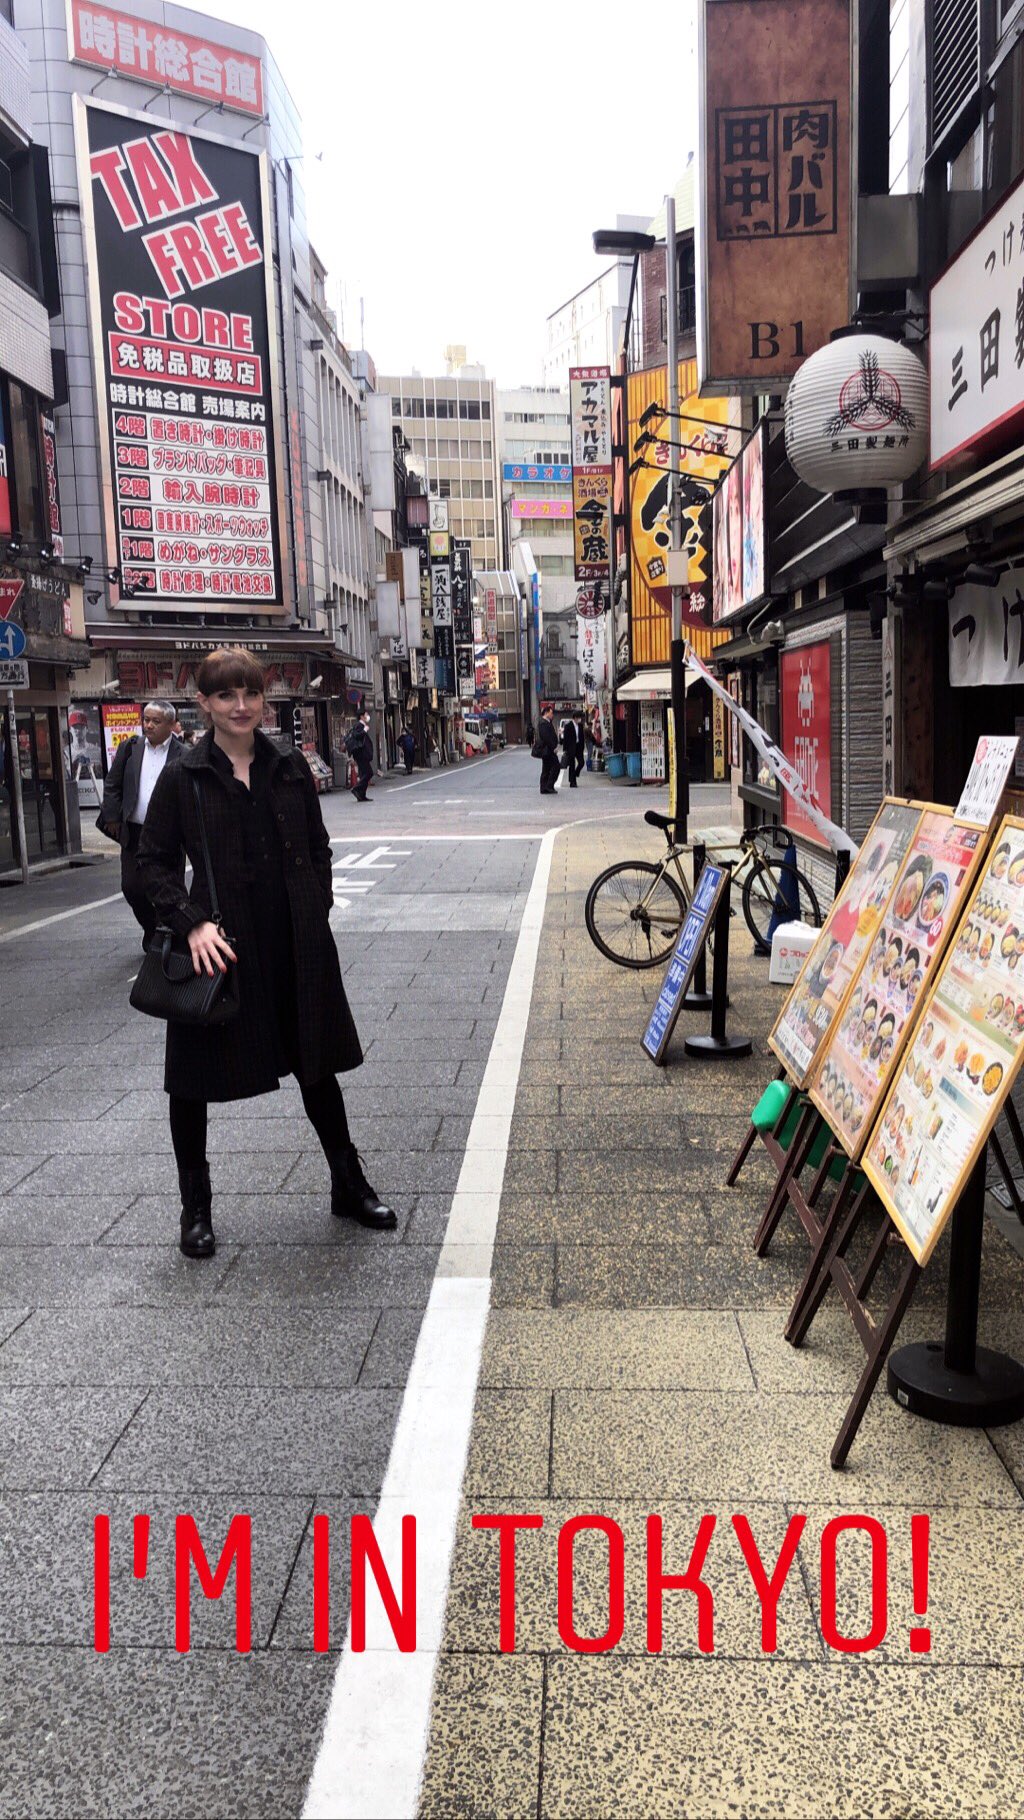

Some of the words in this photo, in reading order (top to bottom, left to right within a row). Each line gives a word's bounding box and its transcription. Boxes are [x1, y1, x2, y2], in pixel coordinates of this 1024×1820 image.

[78, 9, 258, 105] 時計総合館
[89, 130, 219, 232] TAX
[724, 114, 770, 217] 田中
[782, 109, 829, 230] 肉バル
[141, 201, 263, 299] FREE
[113, 291, 254, 352] STORE
[747, 320, 808, 360] B1
[118, 342, 256, 386] 免税品取扱店
[110, 383, 197, 413] 時計総合館
[202, 395, 266, 421] 売場案内
[581, 381, 600, 464] アカマル屋
[116, 415, 146, 437] 4階
[150, 417, 265, 451] 置き時計・掛け時計
[118, 445, 148, 467] 3階
[512, 465, 571, 480] カラオケ
[119, 476, 150, 498] 2階
[163, 478, 261, 508] 輸入腕時計
[122, 505, 151, 529] 1階
[158, 540, 271, 567] めがね・サングラス
